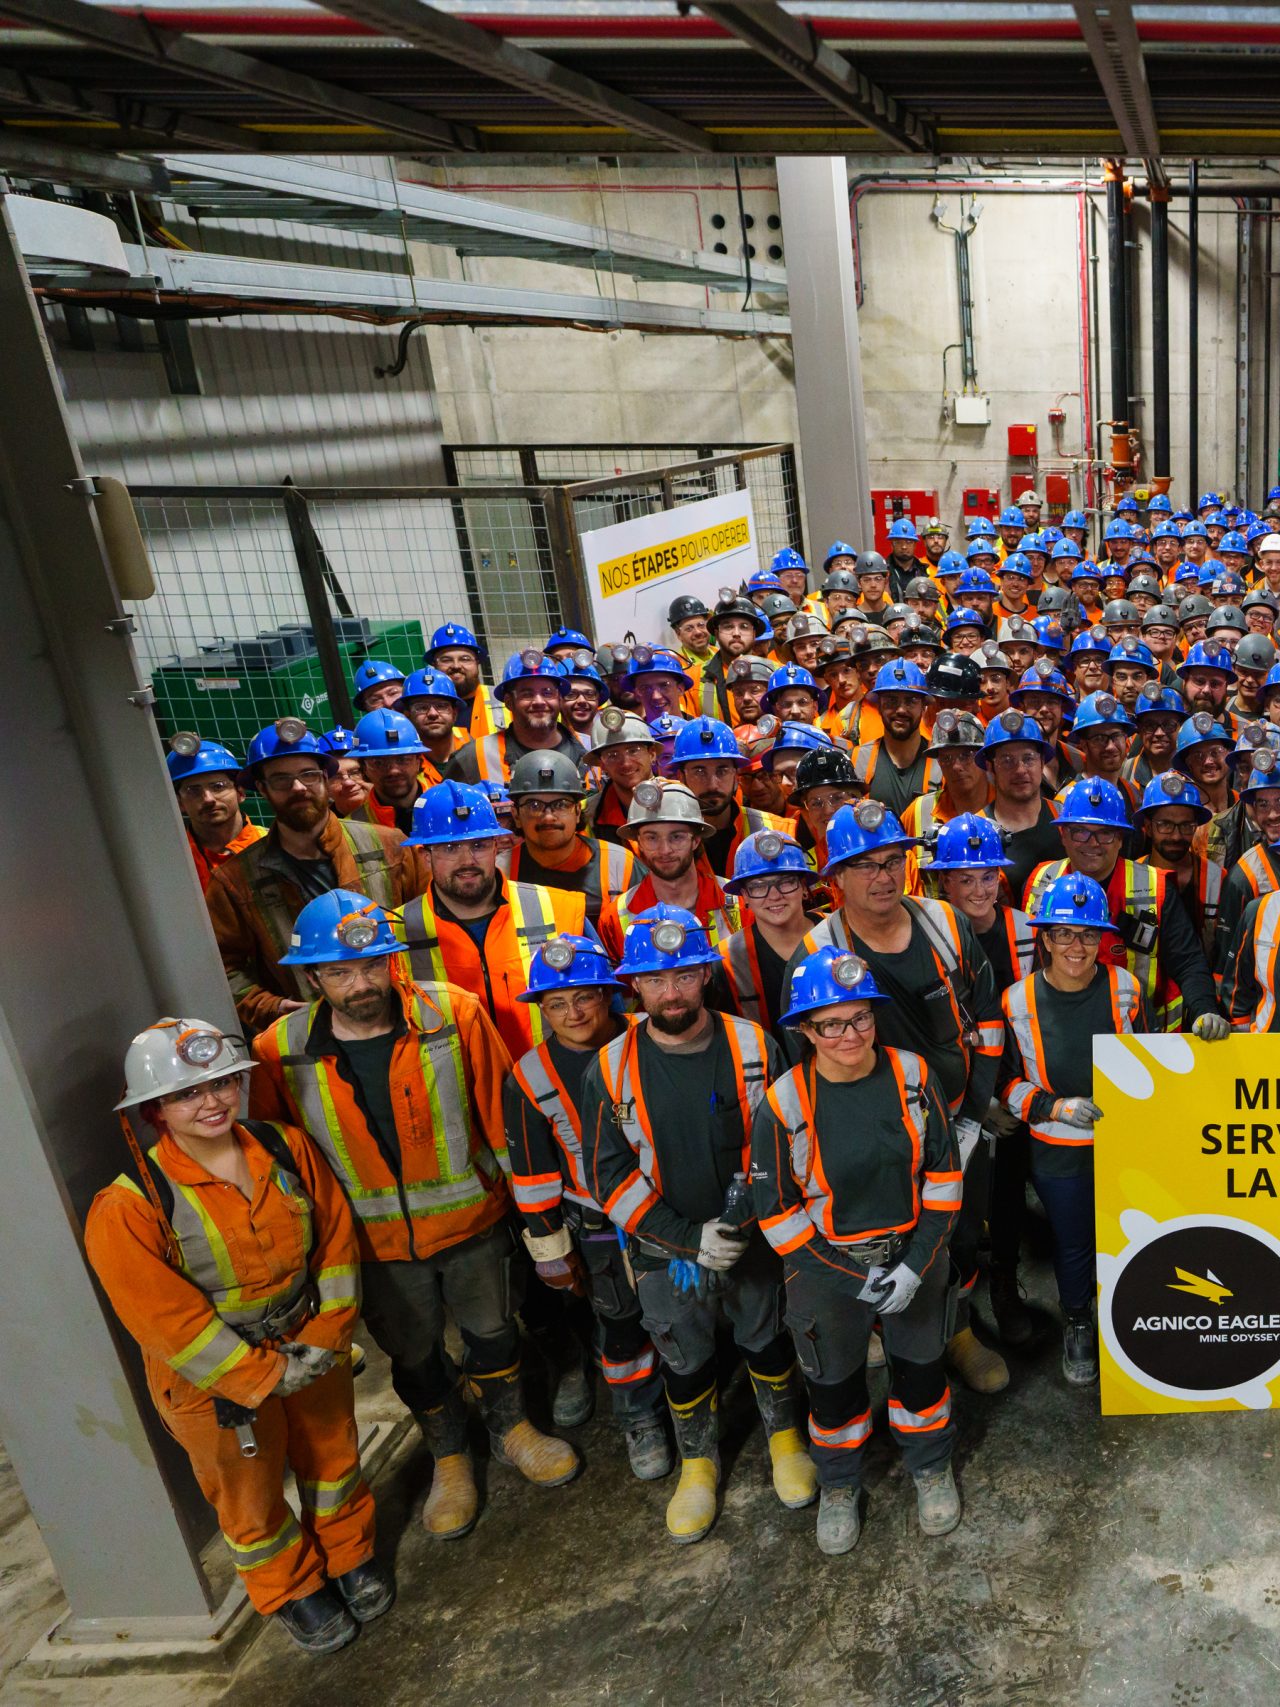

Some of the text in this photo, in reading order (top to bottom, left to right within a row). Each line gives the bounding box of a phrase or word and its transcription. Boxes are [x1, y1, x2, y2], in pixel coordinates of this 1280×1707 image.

[602, 523, 749, 593] NOS ÉTAPES POUR OPÉRER
[1227, 1168, 1278, 1198] LA
[1133, 1314, 1280, 1331] AGNICO EAGLE
[1199, 1333, 1280, 1343] MINE ODYSSEY
